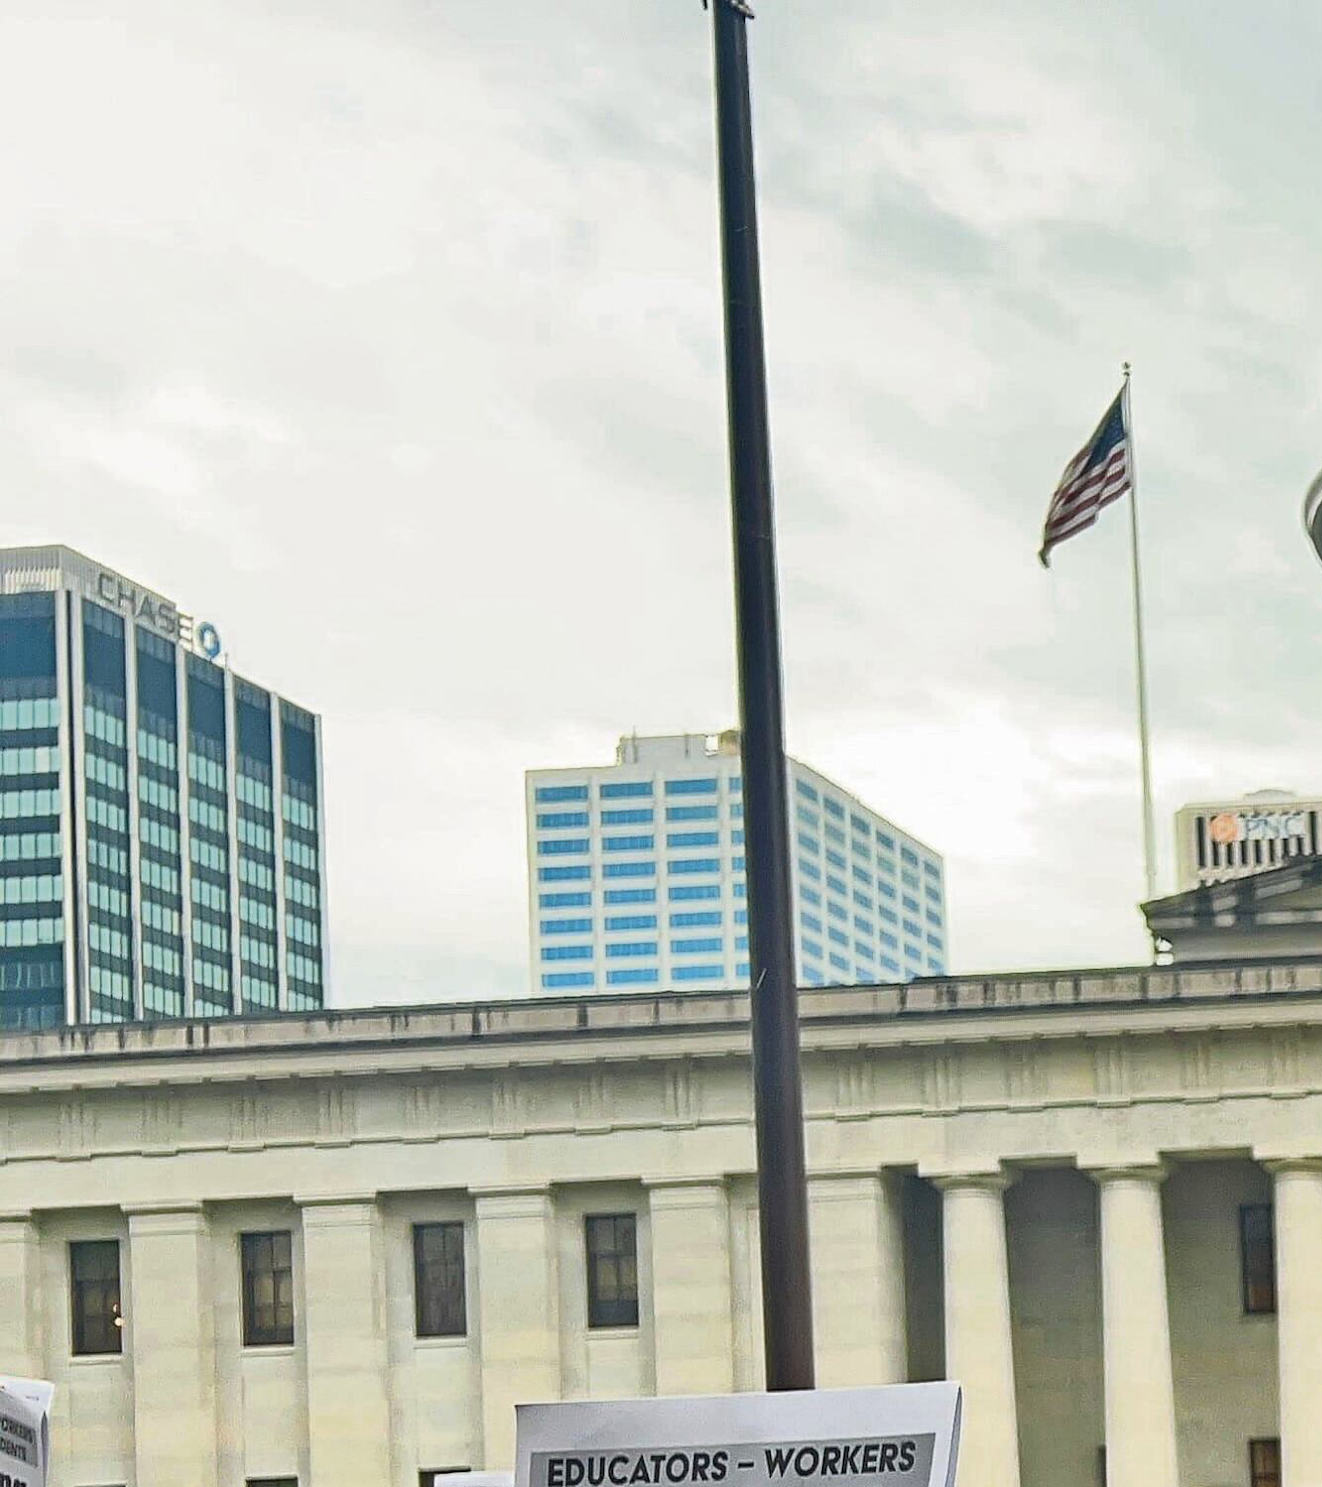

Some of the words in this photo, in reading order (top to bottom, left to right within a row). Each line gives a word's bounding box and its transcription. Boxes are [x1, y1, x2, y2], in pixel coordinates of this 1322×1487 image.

[99, 572, 194, 642] CHASE
[547, 1451, 728, 1487] EDUCATORS
[765, 1440, 917, 1477] WORKERS
